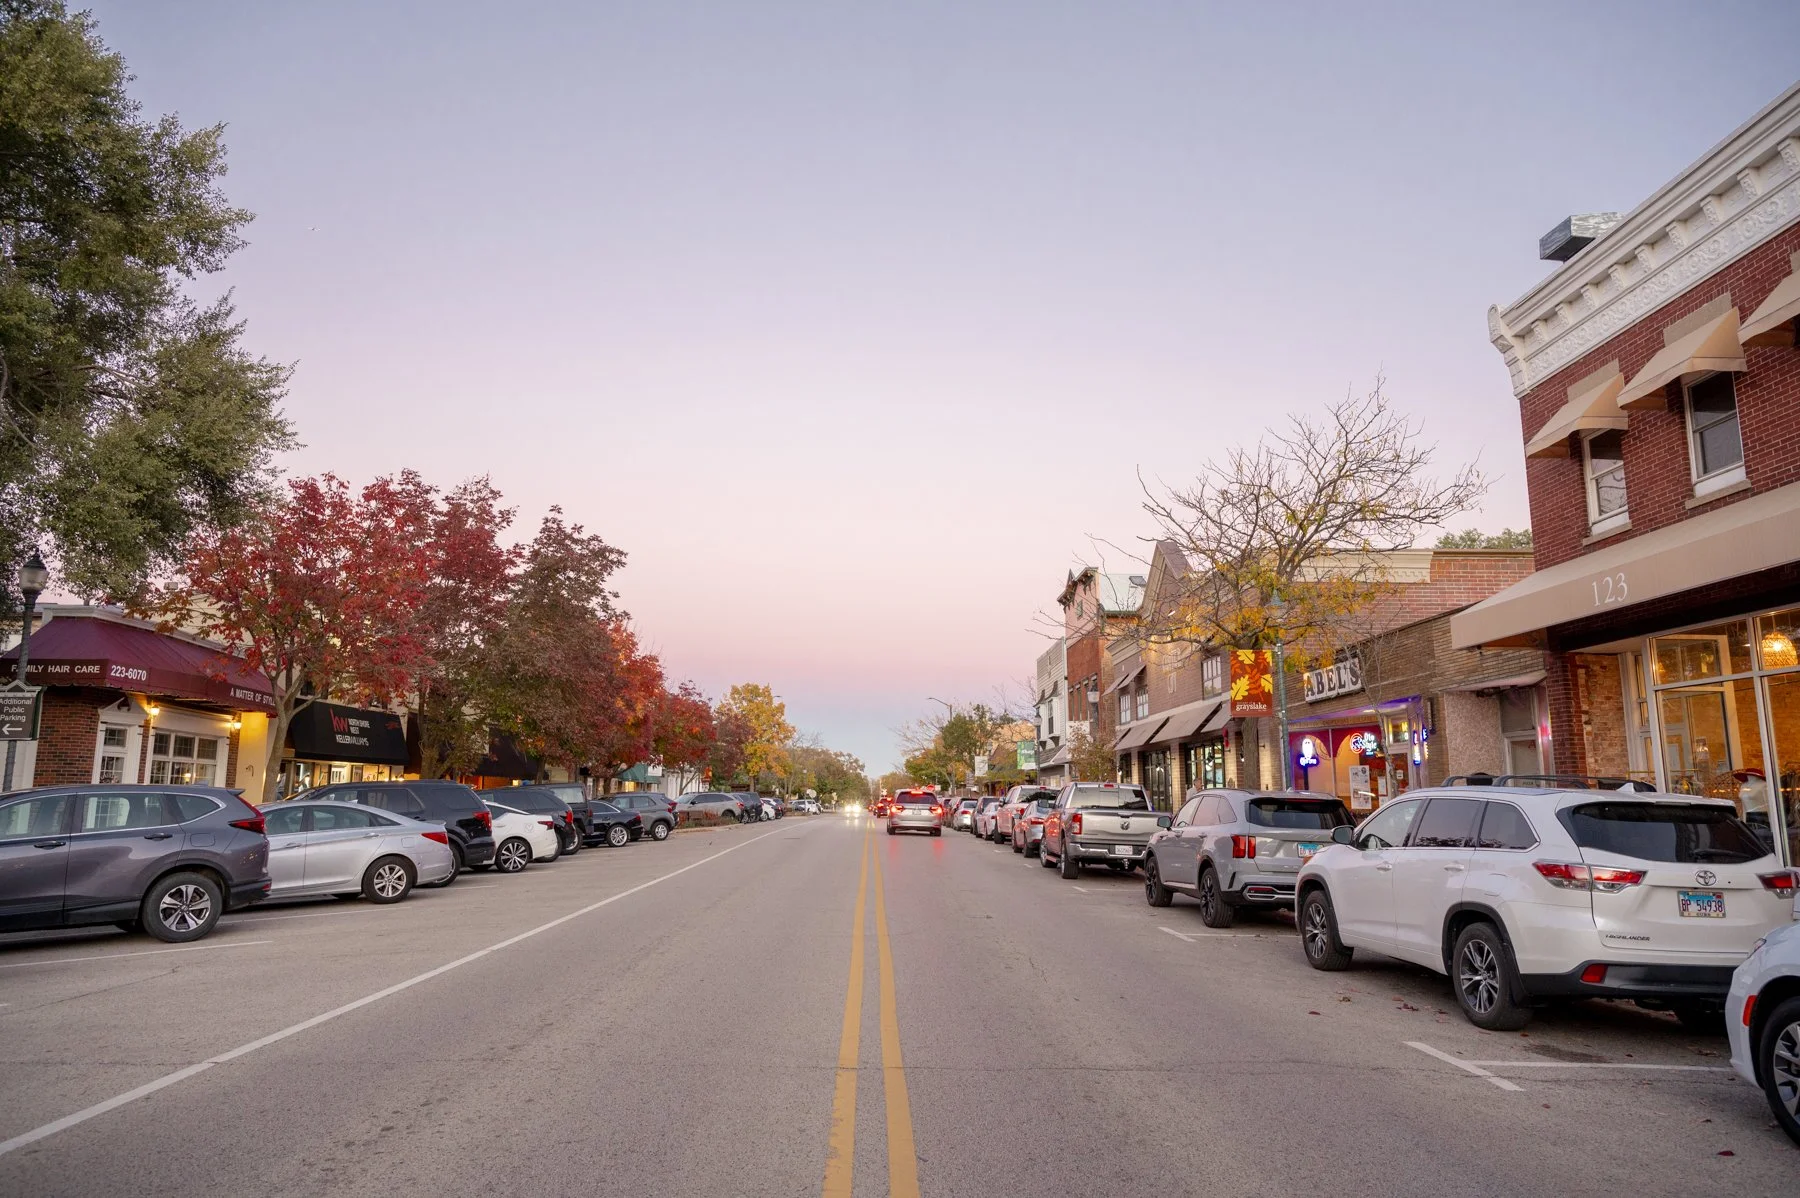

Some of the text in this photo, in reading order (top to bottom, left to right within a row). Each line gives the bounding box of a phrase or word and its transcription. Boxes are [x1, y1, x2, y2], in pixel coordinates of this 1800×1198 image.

[1592, 572, 1627, 606] 123
[11, 665, 100, 673] FMILY HAIR CARE
[110, 665, 147, 680] 223-6070
[1304, 661, 1360, 697] ABEL'S
[230, 687, 276, 706] A MATTER OF STYL
[1236, 702, 1267, 711] grayslake
[1696, 899, 1723, 912] 54938
